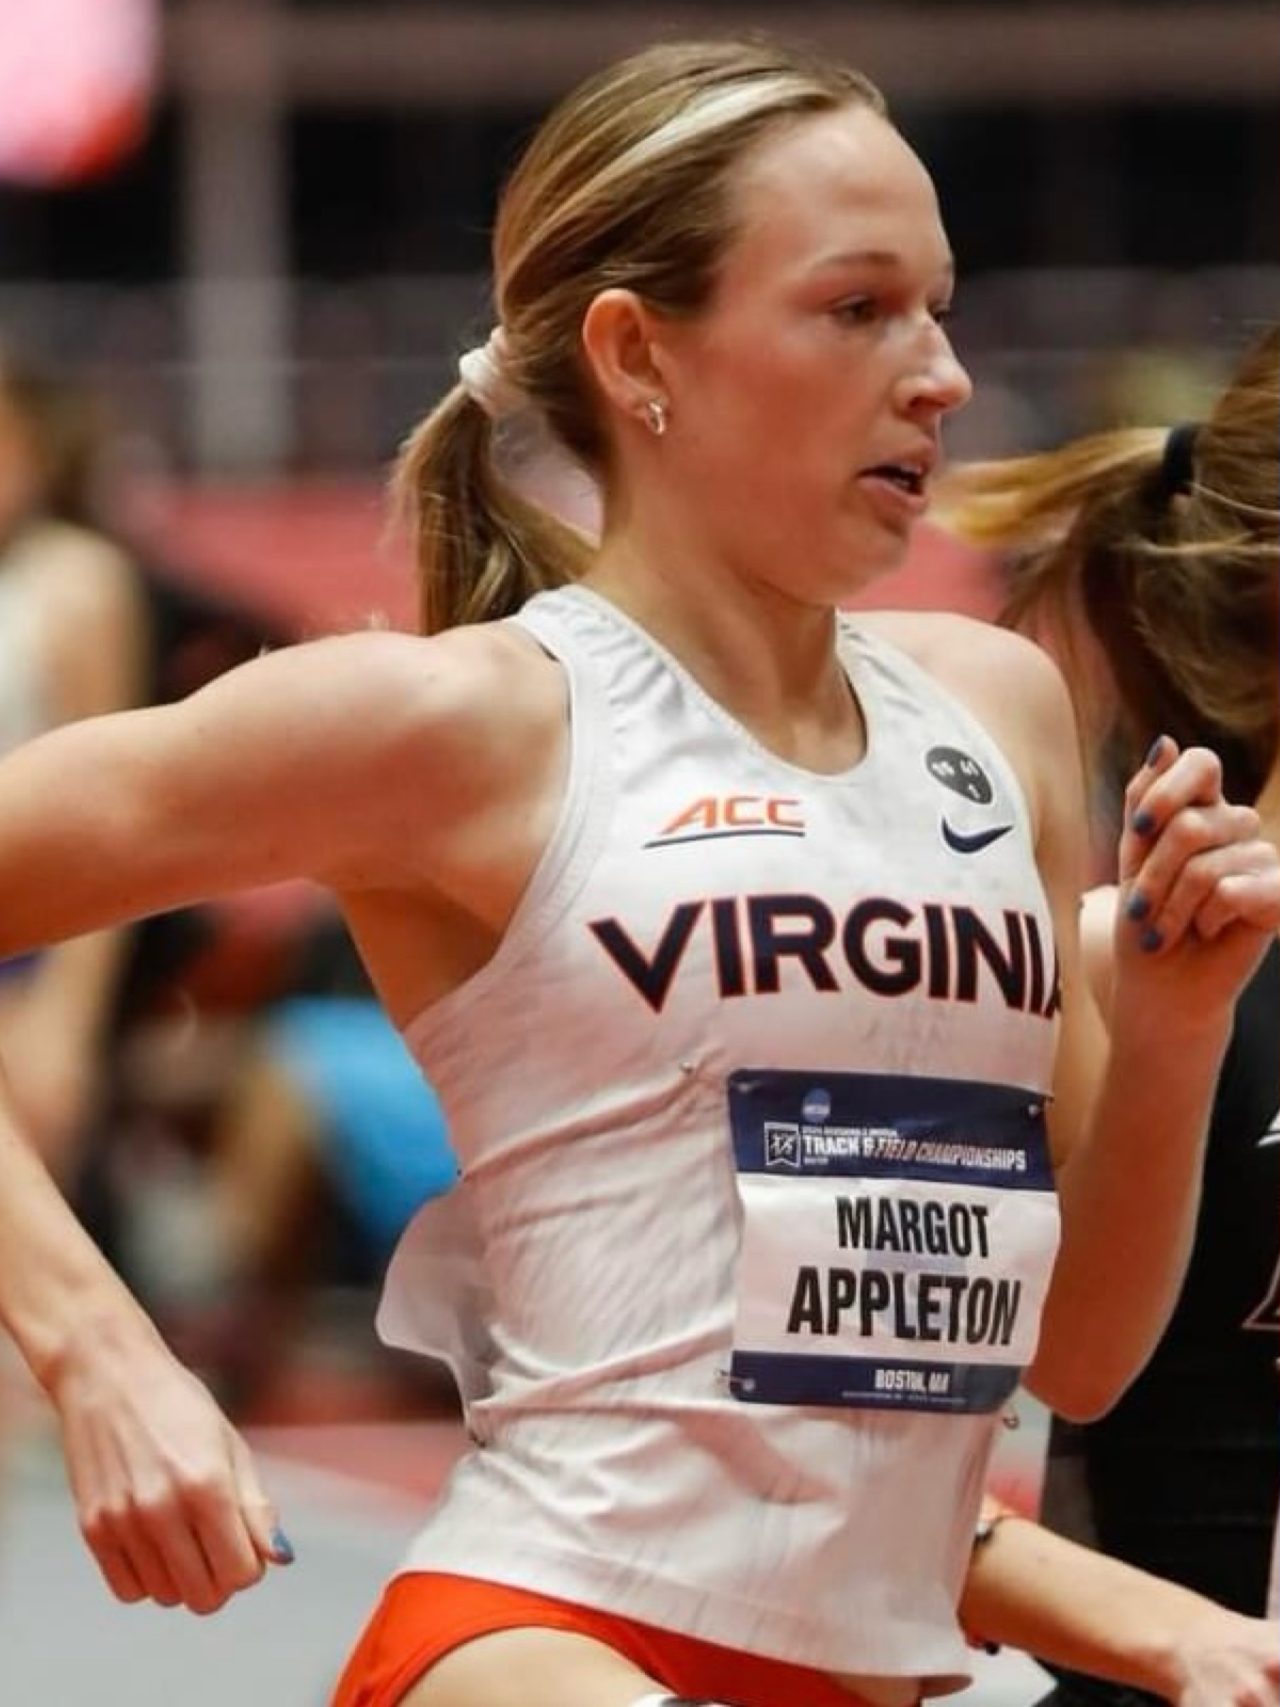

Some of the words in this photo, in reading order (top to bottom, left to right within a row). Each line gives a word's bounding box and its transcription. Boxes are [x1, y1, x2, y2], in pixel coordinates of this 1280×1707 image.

[659, 797, 806, 834] ACC
[802, 1135, 859, 1156] TRACK
[874, 1139, 917, 1161] FIELD
[915, 1141, 1027, 1172] CHAMPIONSHIPS
[836, 1196, 989, 1259] MARGOT
[786, 1265, 1022, 1347] APPLETON
